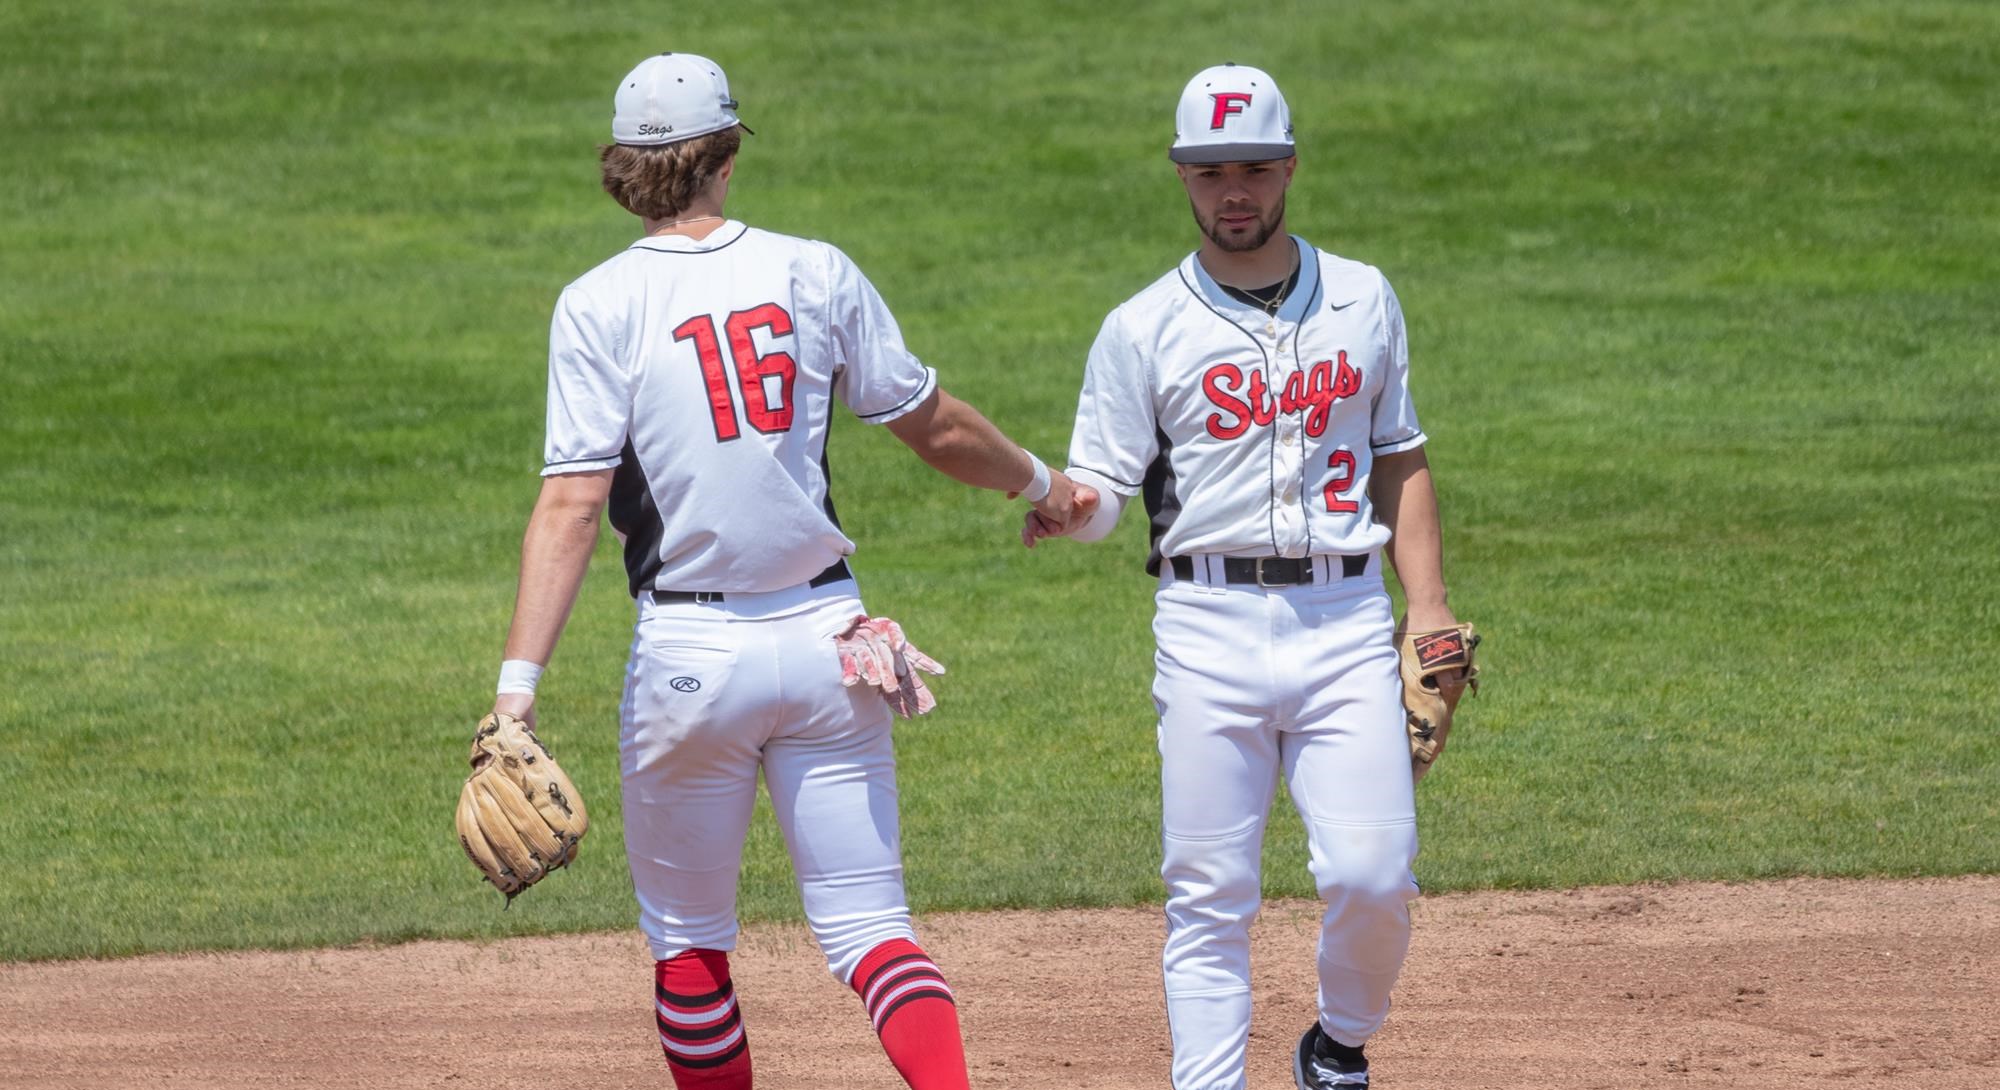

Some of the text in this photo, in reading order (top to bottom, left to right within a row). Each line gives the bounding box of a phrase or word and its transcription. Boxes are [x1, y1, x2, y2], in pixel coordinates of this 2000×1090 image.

[638, 124, 674, 137] Stags
[1208, 92, 1252, 131] F
[672, 302, 796, 443] 16
[1202, 350, 1362, 440] Stags
[1324, 450, 1359, 513] 2
